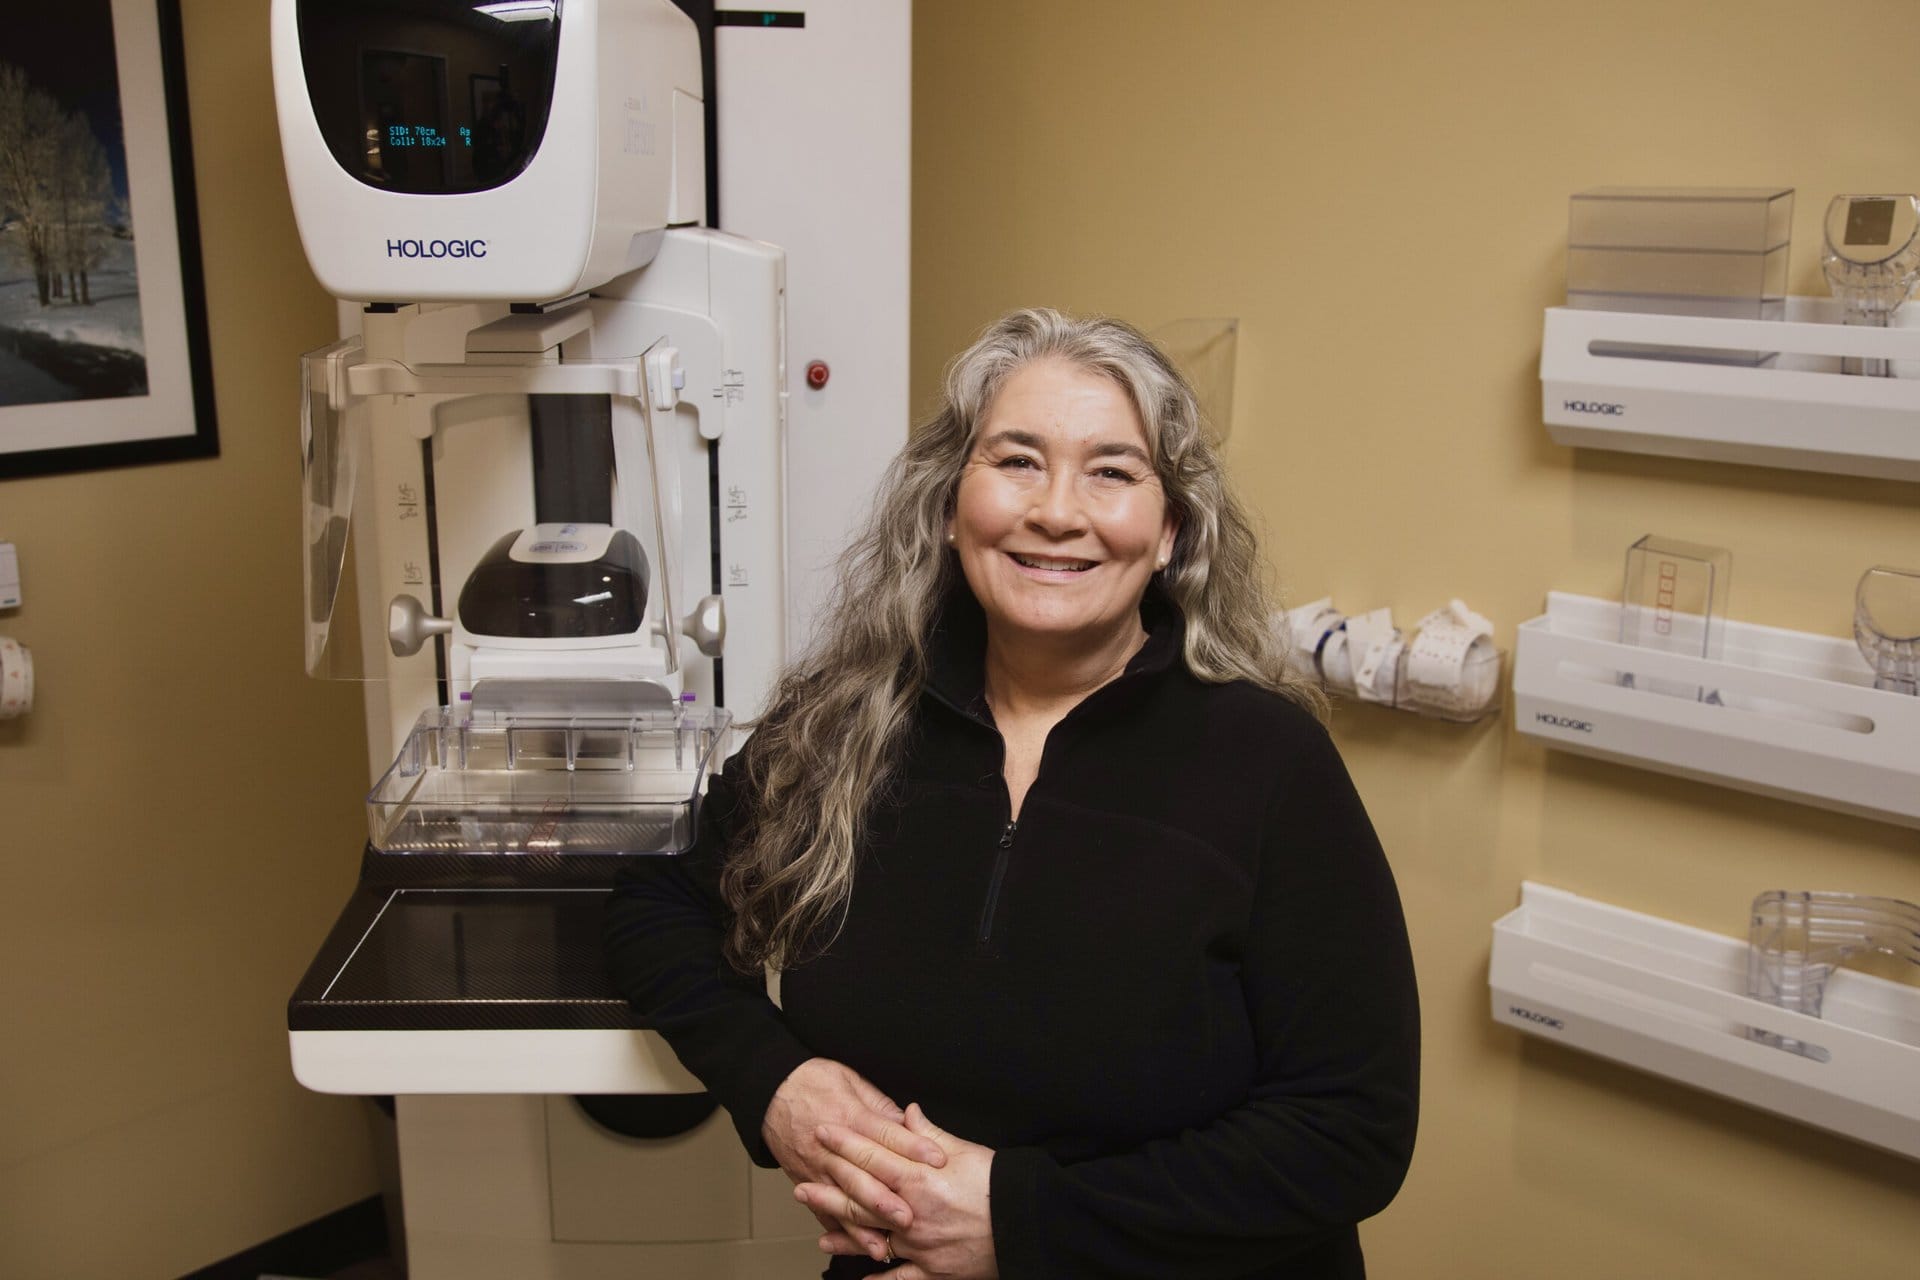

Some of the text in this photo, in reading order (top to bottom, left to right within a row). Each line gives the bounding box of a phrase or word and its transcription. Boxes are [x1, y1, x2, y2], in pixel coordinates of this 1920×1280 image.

[389, 126, 409, 136] SID:
[415, 126, 436, 136] 70cm
[421, 136, 446, 146] 18x24
[387, 239, 487, 258] HOLOGIC
[1563, 400, 1625, 416] HOLOGIC
[1535, 712, 1593, 733] HOLOGIC
